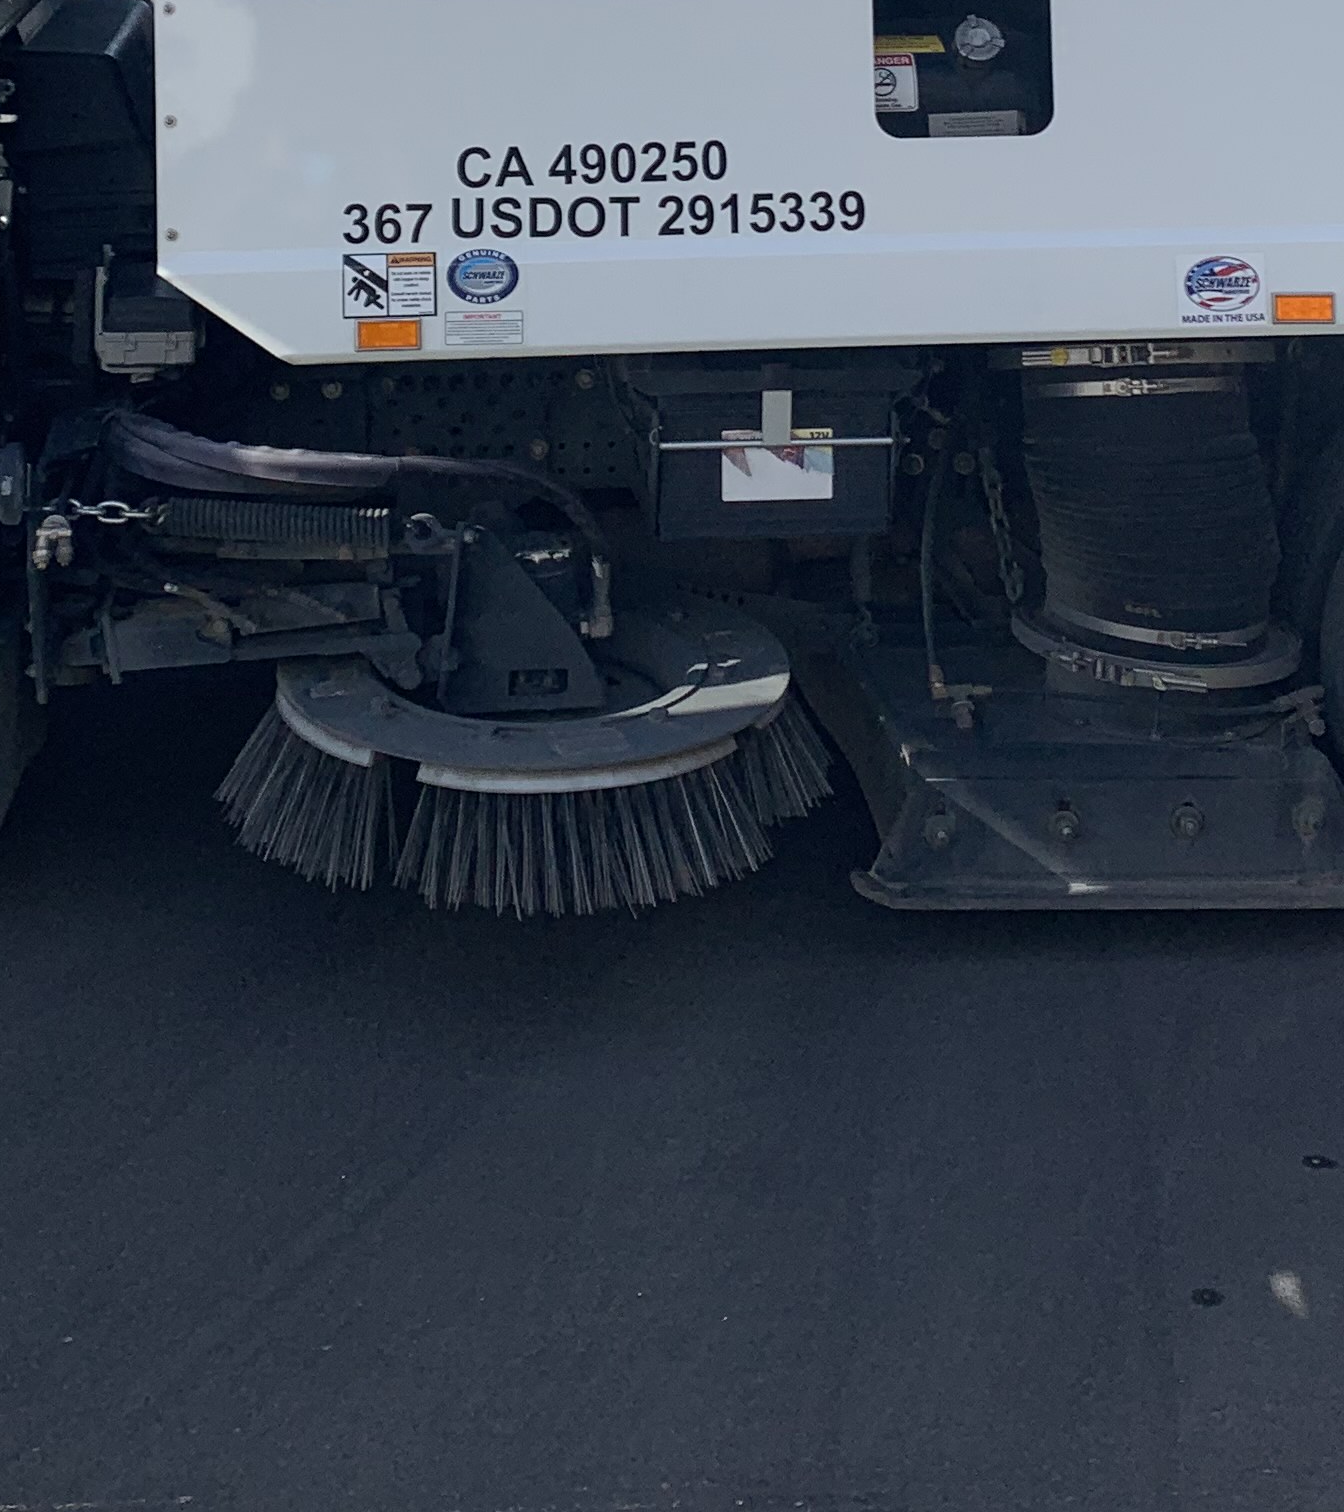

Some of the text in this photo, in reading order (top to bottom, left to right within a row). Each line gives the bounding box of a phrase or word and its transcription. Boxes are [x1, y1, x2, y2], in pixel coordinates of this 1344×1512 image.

[875, 56, 910, 65] NGER
[458, 140, 726, 188] CA 490250
[343, 191, 864, 244] 367 USDOT 2915339
[458, 249, 506, 261] GENUINE
[1196, 276, 1252, 289] SCHWARZE
[466, 294, 501, 303] PARTS
[1182, 313, 1265, 324] MADE IN THE USA
